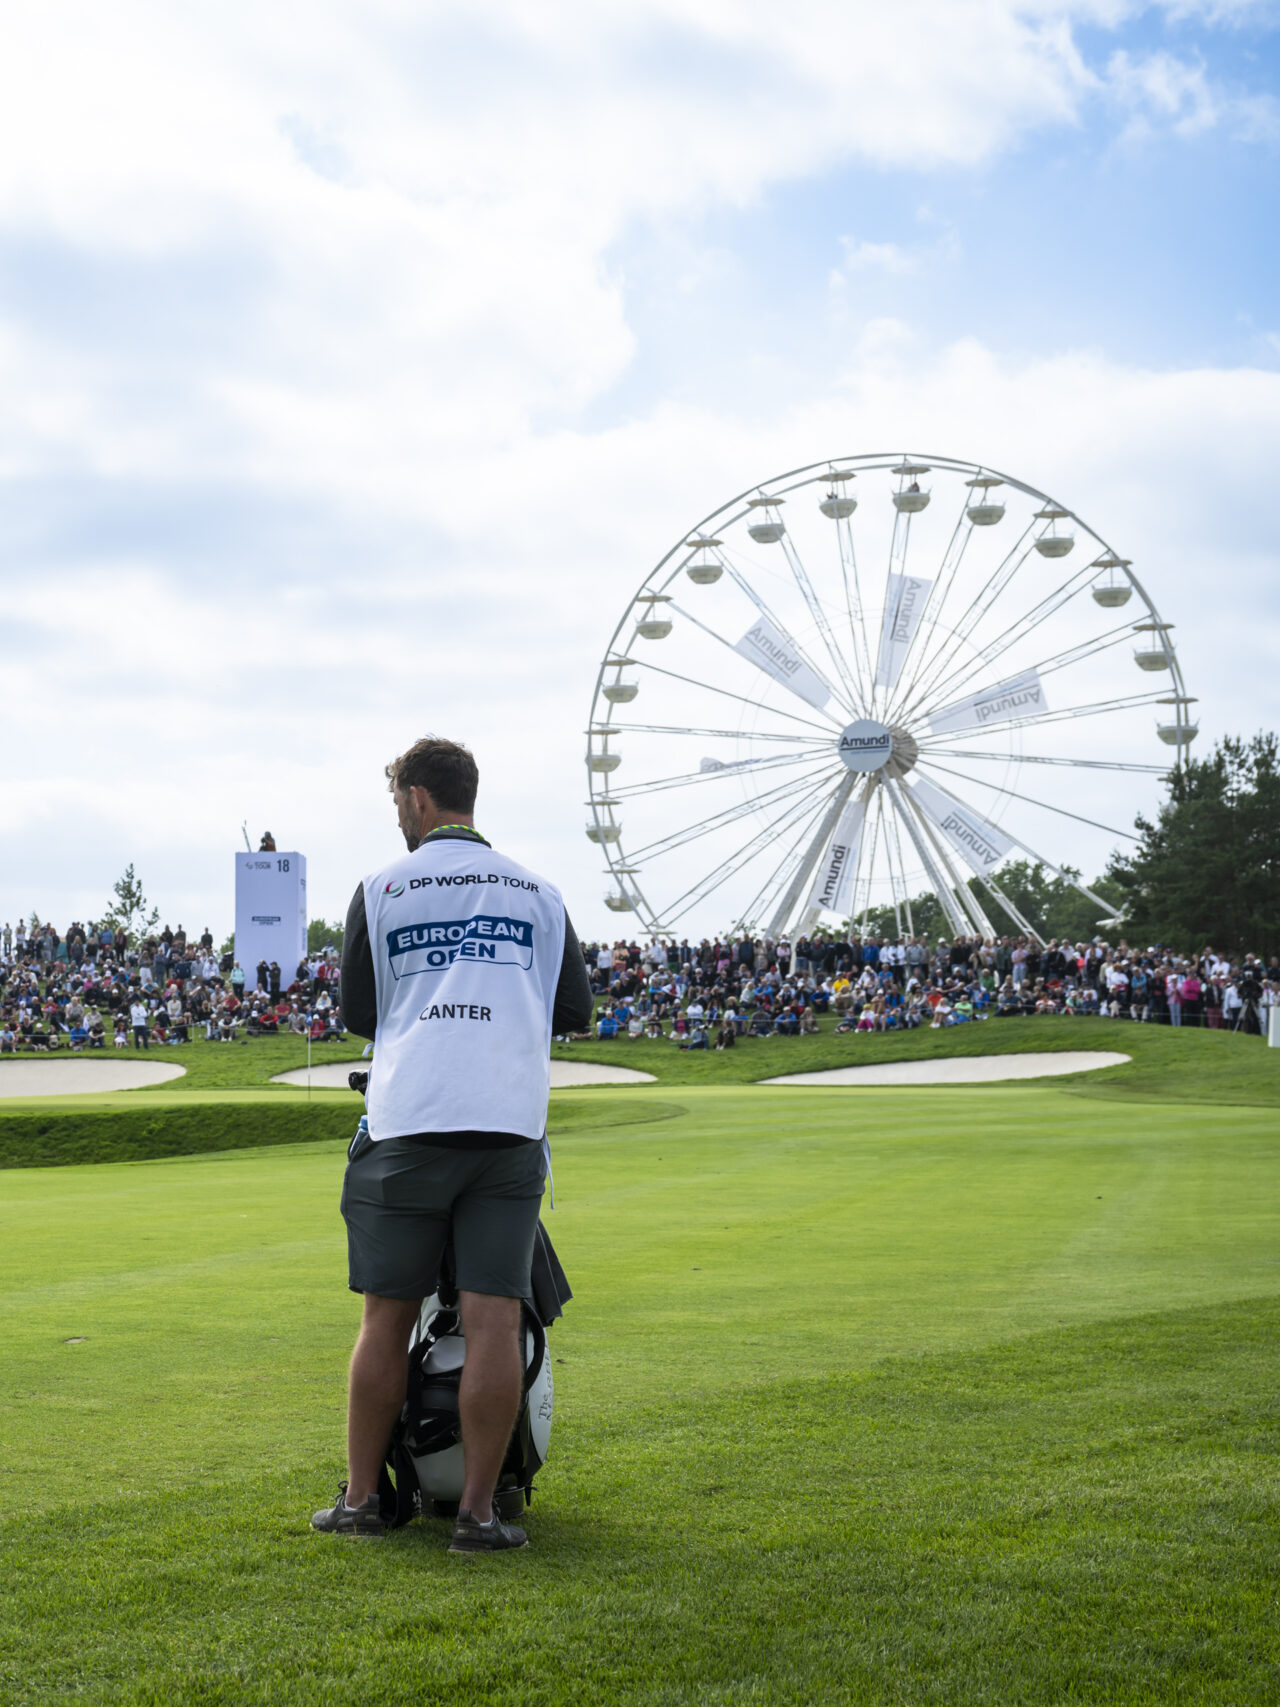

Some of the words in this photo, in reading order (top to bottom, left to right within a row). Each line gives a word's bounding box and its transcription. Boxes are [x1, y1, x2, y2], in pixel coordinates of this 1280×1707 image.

[893, 577, 922, 644] Amundi
[748, 627, 802, 675] Amundi
[975, 688, 1041, 722] Amundi
[840, 733, 890, 747] Amundi
[940, 815, 999, 865] Amundi
[277, 859, 290, 873] 18
[817, 844, 847, 909] Amundi
[409, 877, 433, 890] DP
[435, 874, 499, 887] WORLD
[501, 875, 540, 893] TOUR
[396, 920, 524, 949] EUROPEAN
